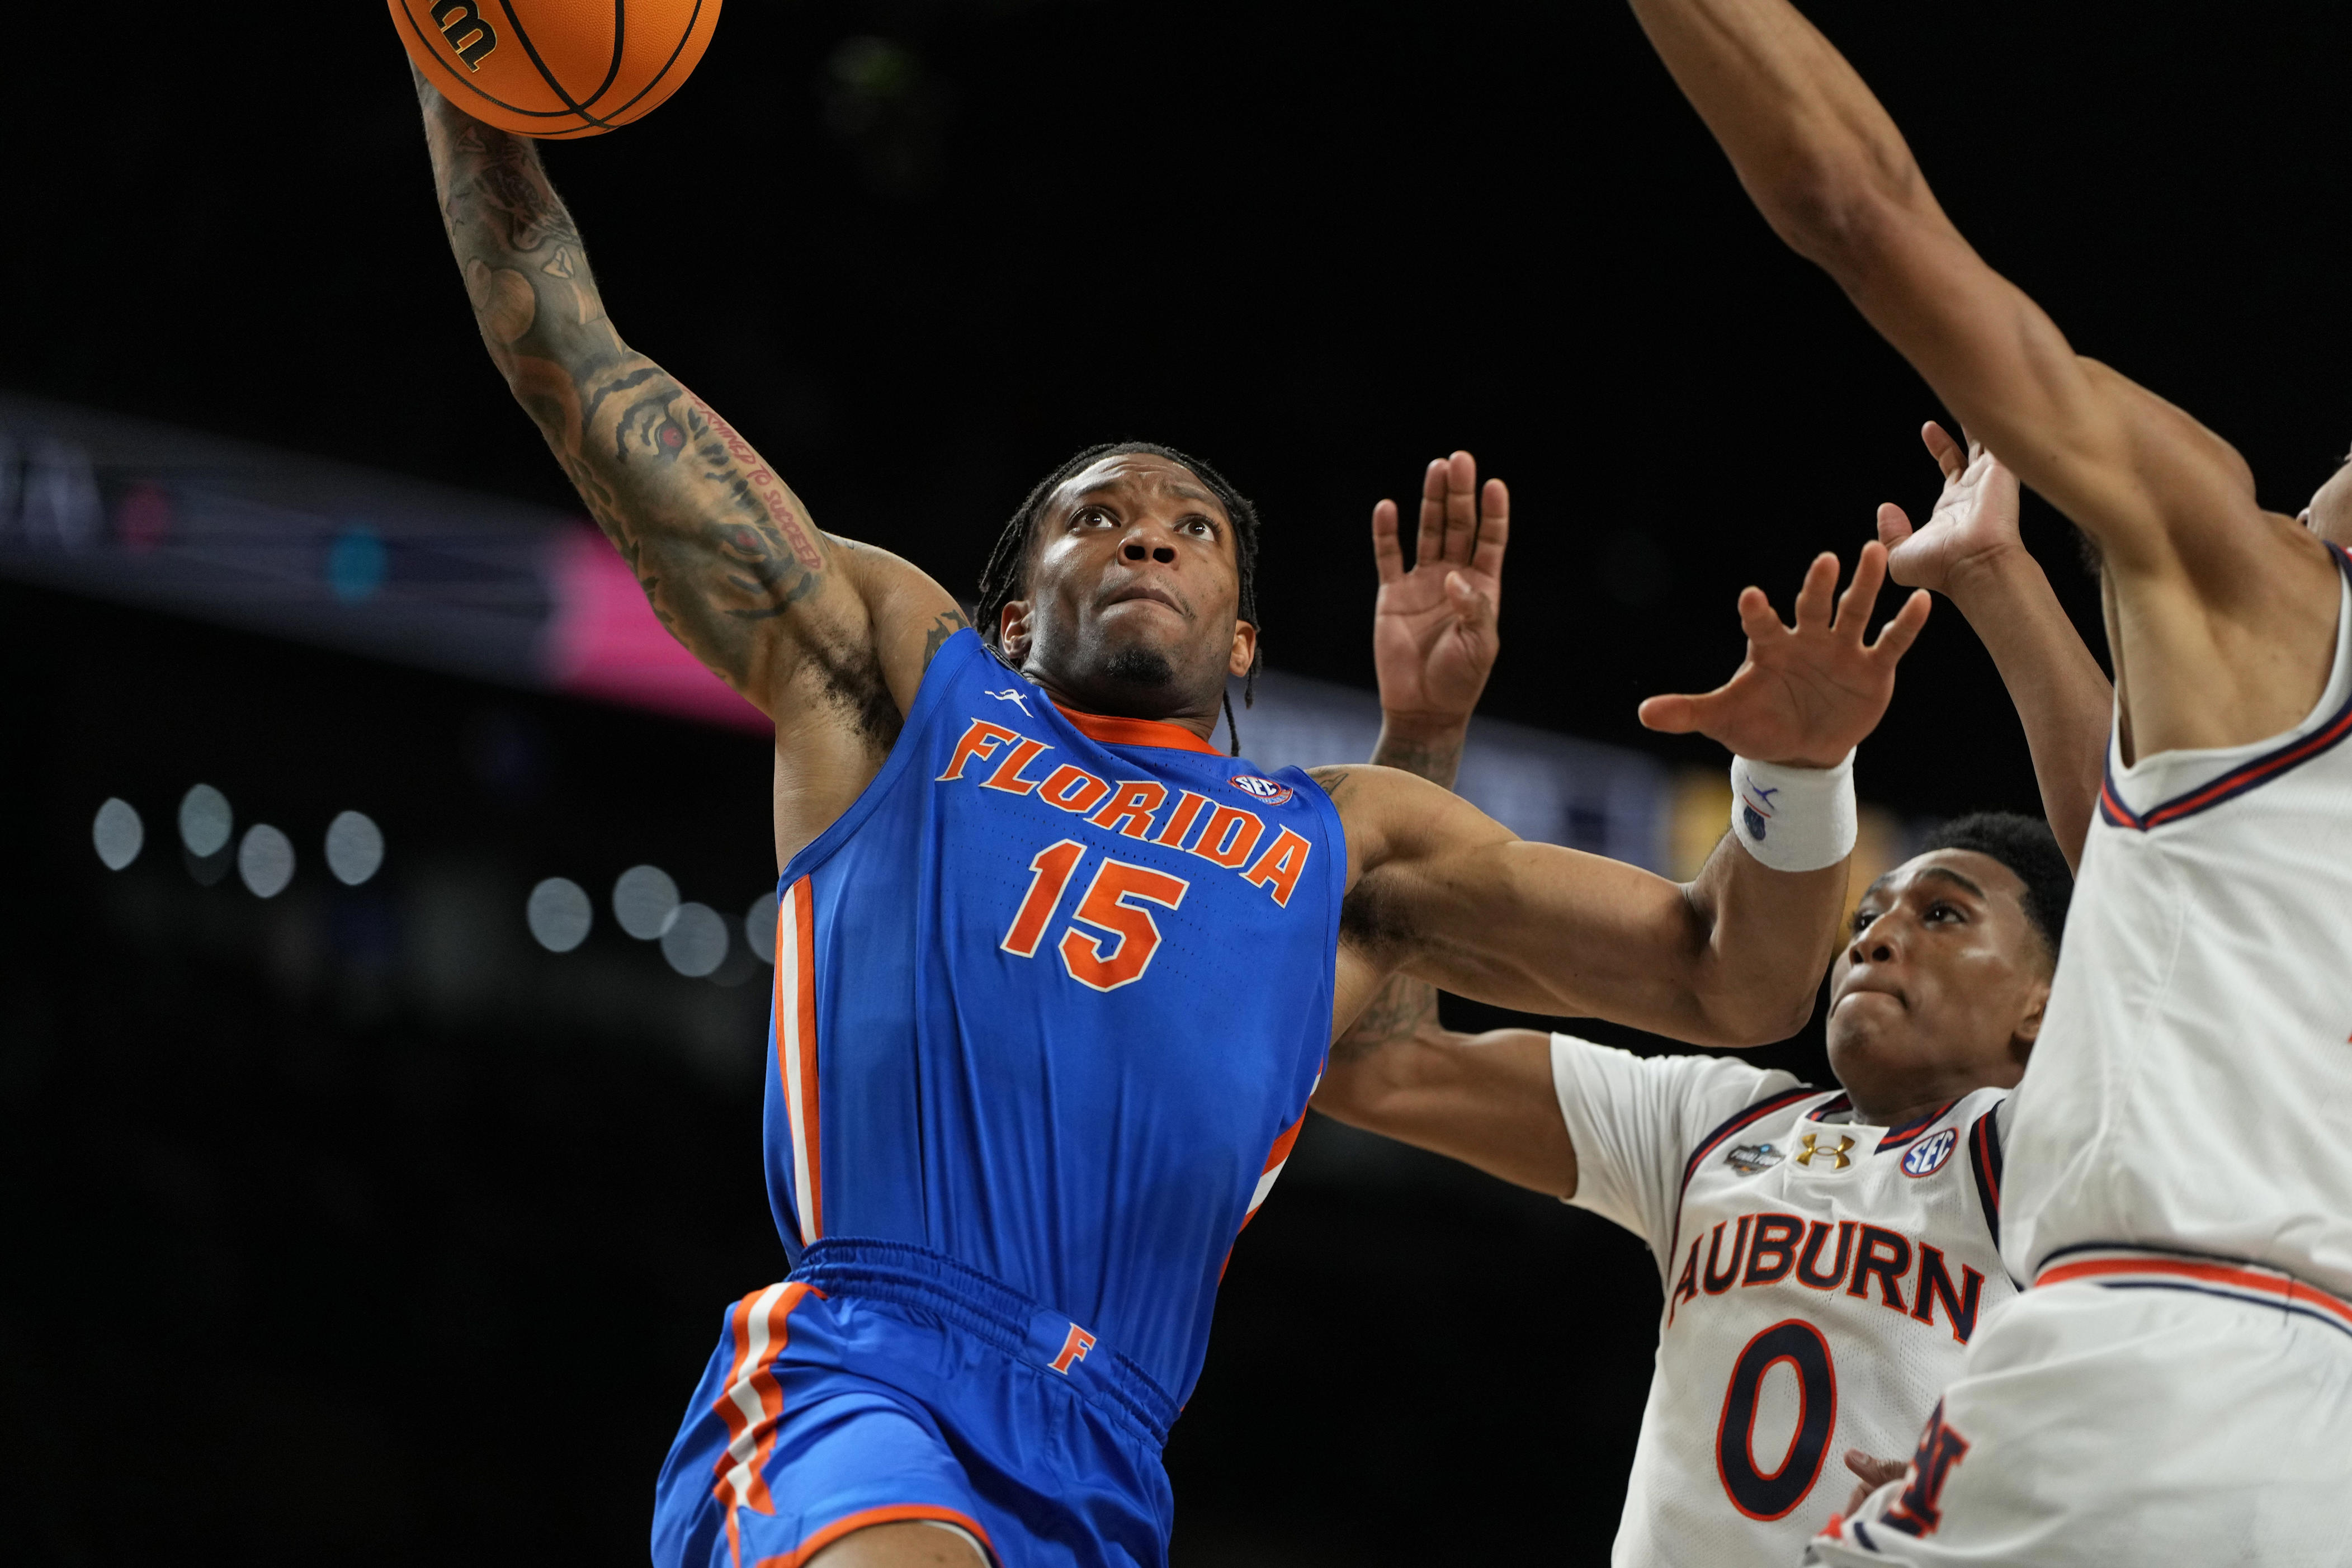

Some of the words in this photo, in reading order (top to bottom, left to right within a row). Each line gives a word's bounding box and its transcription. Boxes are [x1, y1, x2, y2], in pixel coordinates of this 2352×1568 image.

[747, 463, 773, 486] TO
[763, 489, 821, 569] SUCCEED
[935, 717, 1311, 909] FLORIDA
[1234, 776, 1278, 796] SEC
[1000, 838, 1190, 993] 15
[1905, 1129, 1955, 1174] SEC
[1669, 1212, 1985, 1345] AUBURN
[1046, 1321, 1097, 1376] F
[1716, 1318, 1837, 1522] 0
